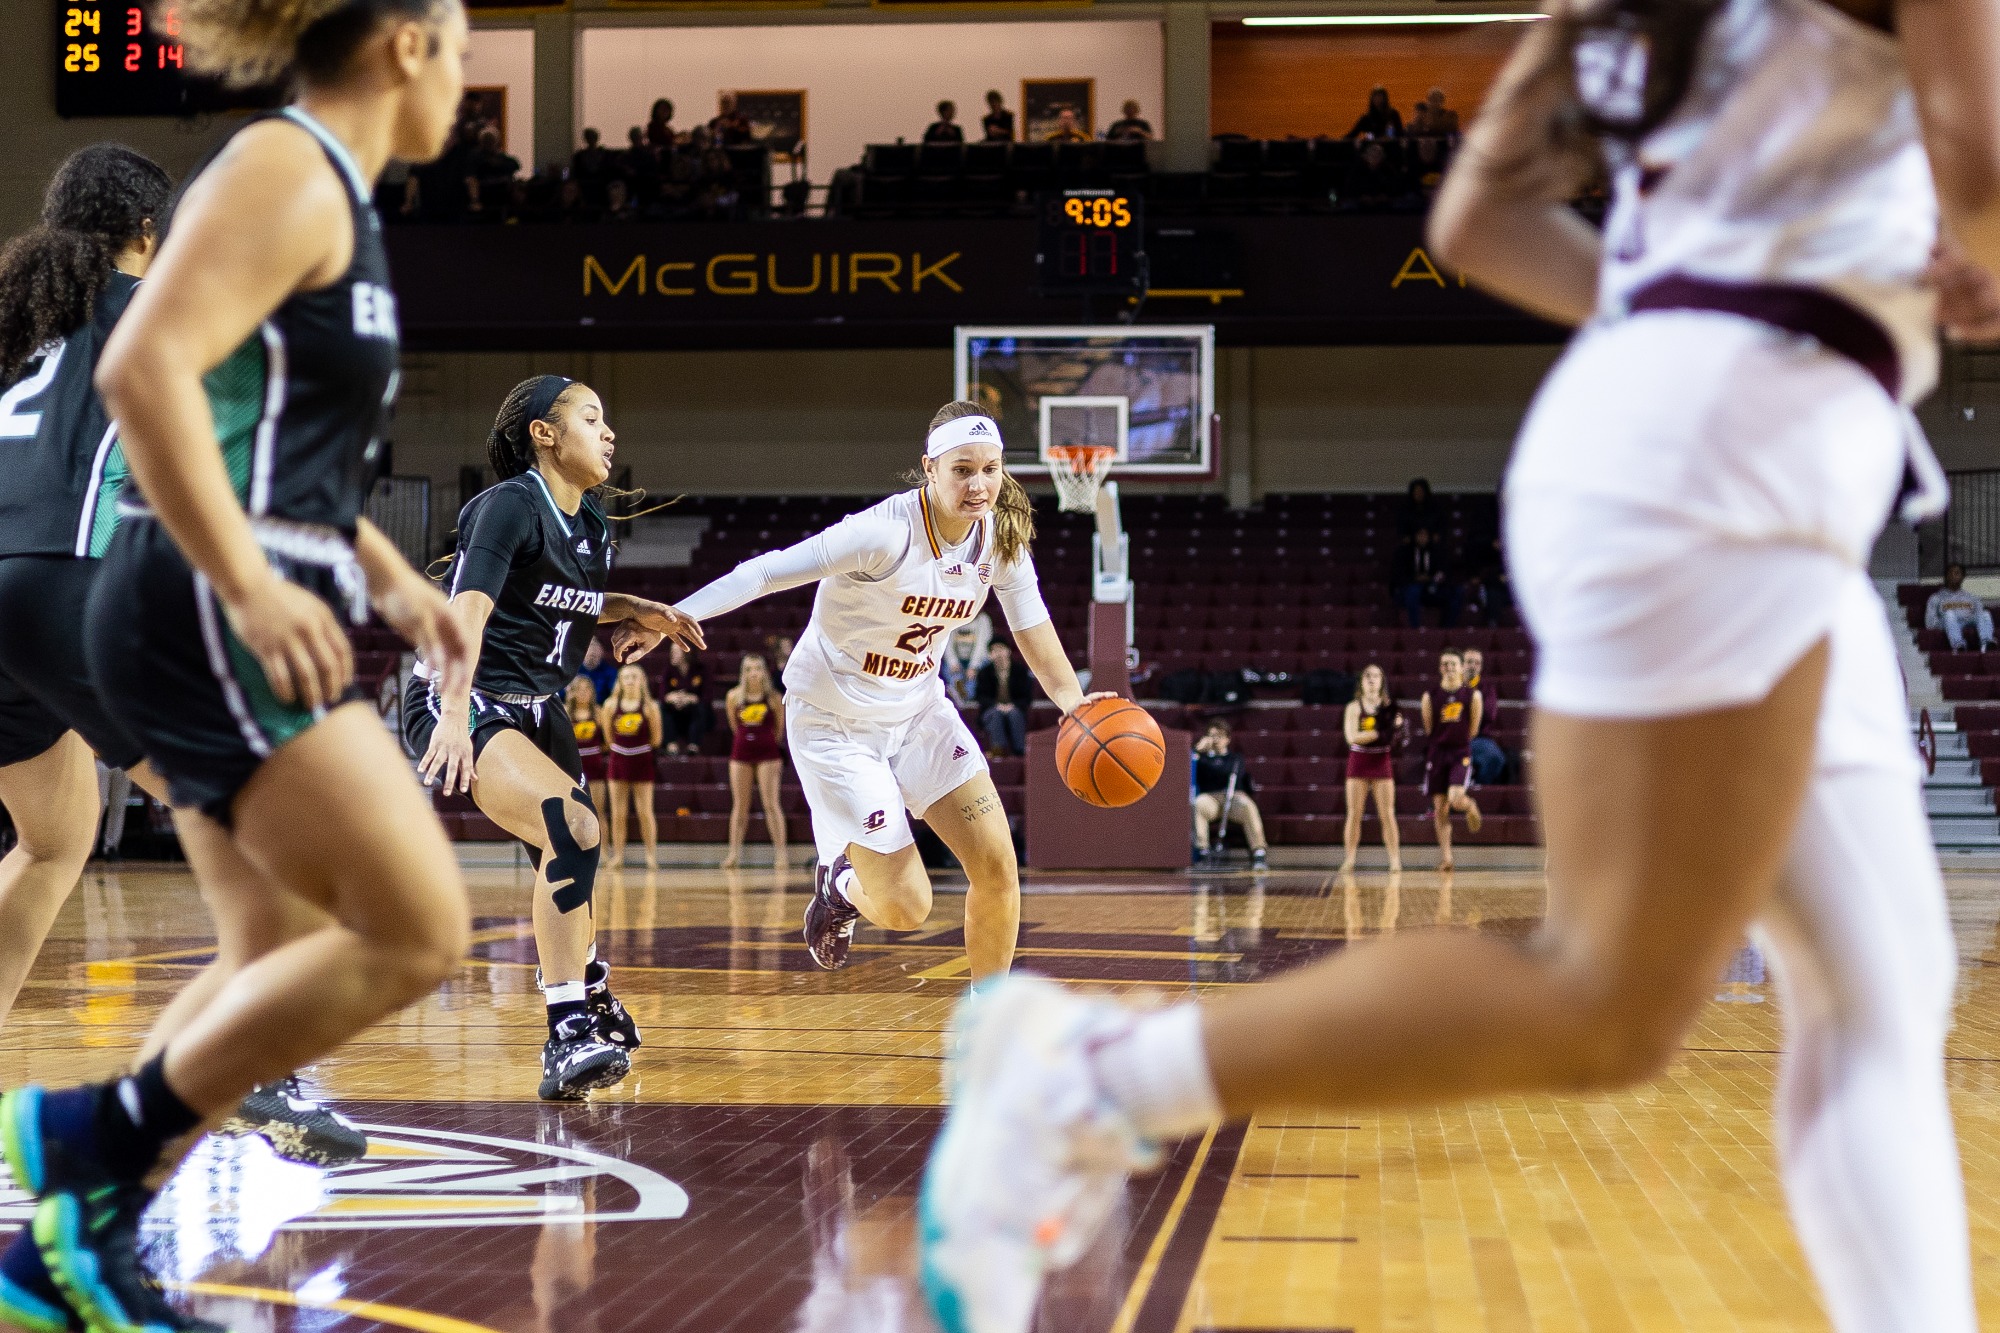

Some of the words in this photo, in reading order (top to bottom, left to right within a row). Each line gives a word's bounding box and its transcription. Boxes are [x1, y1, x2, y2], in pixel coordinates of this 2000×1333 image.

[64, 8, 100, 37] 24
[126, 8, 142, 36] 3
[166, 8, 181, 36] 6
[64, 43, 100, 72] 25
[124, 43, 142, 72] 2
[158, 44, 183, 69] 14
[1065, 198, 1131, 228] 9:05
[533, 583, 604, 616] EASTERN
